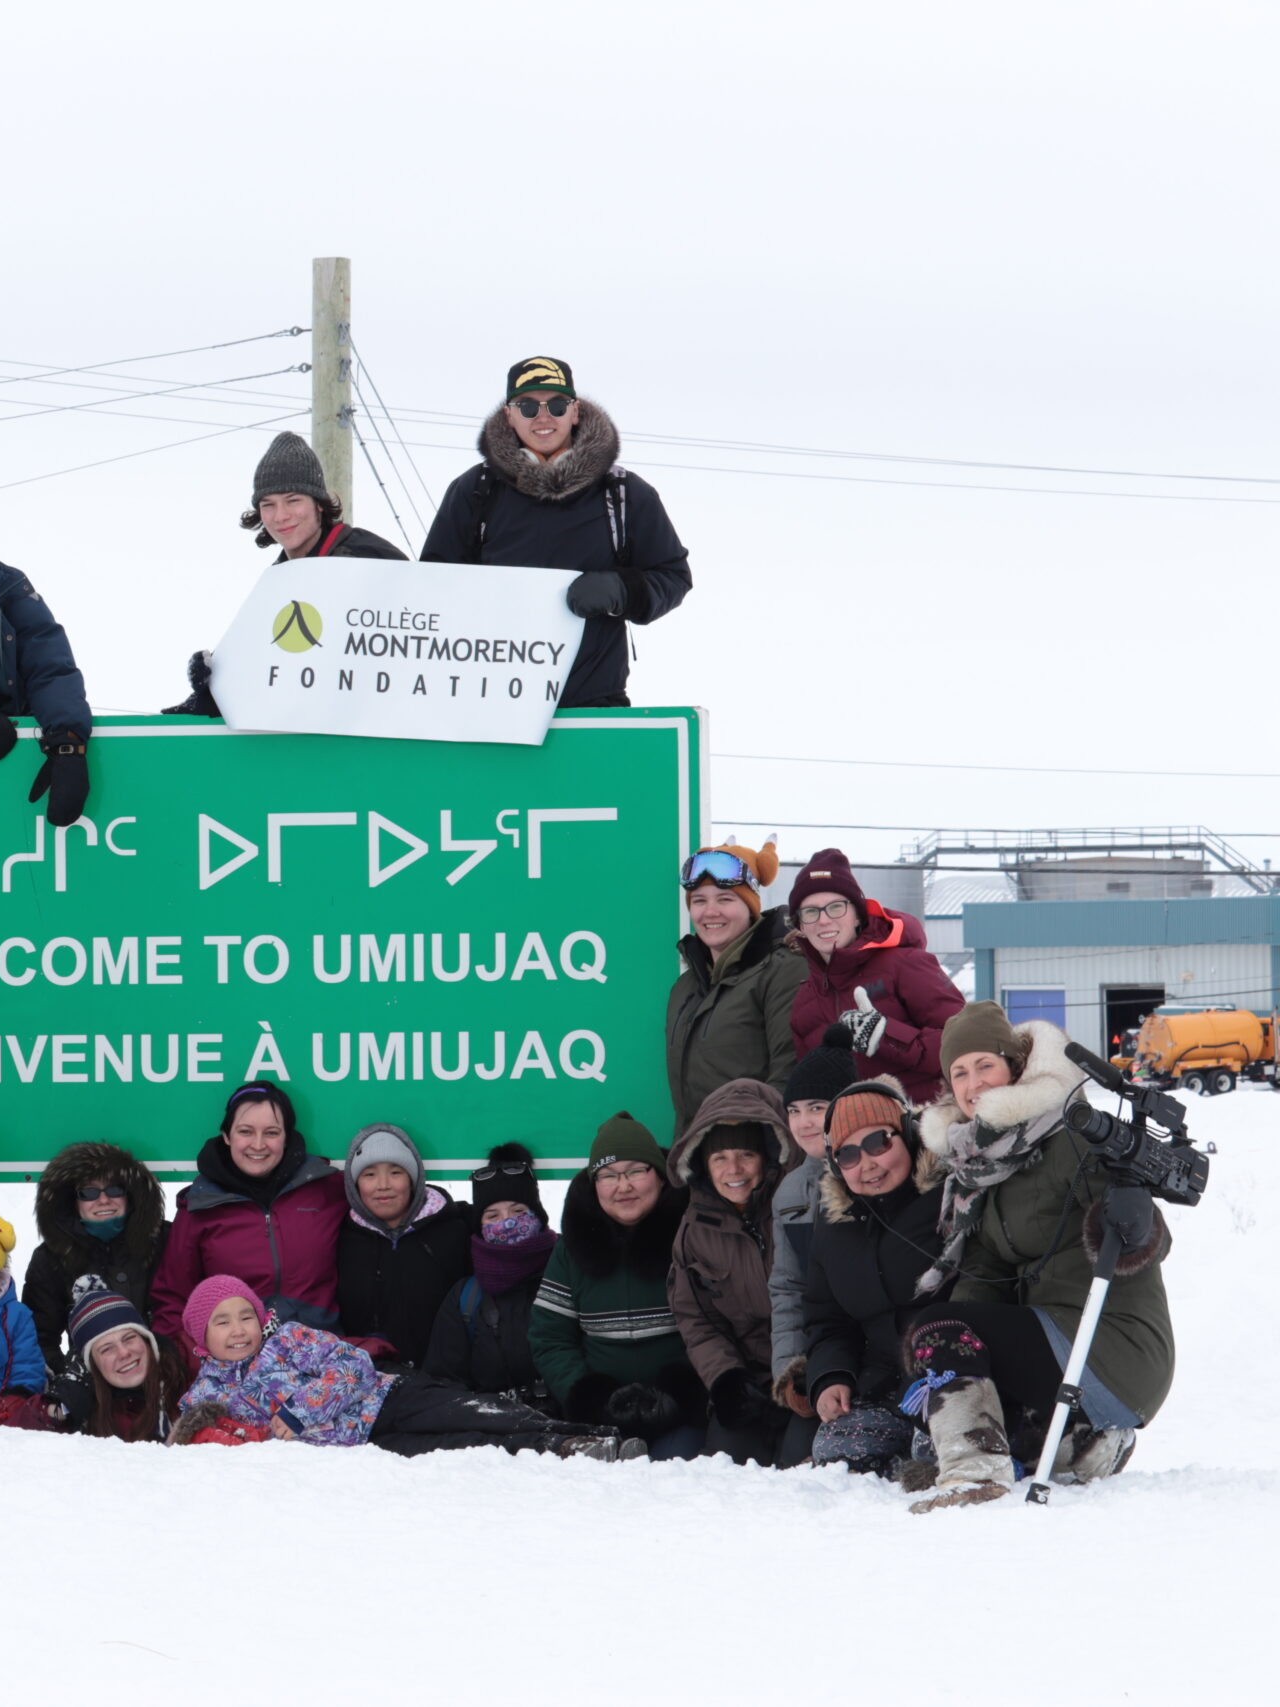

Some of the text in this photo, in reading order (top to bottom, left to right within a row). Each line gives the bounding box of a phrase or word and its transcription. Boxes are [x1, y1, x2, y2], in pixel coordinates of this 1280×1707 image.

[346, 606, 440, 632] COLLÈGE
[344, 631, 565, 666] MONTMORENCY
[269, 665, 560, 702] FONDATION
[203, 934, 290, 985] TO
[313, 931, 608, 984] UMIUJAQ
[243, 1020, 291, 1082] À
[312, 1030, 607, 1082] UMIUJAQ
